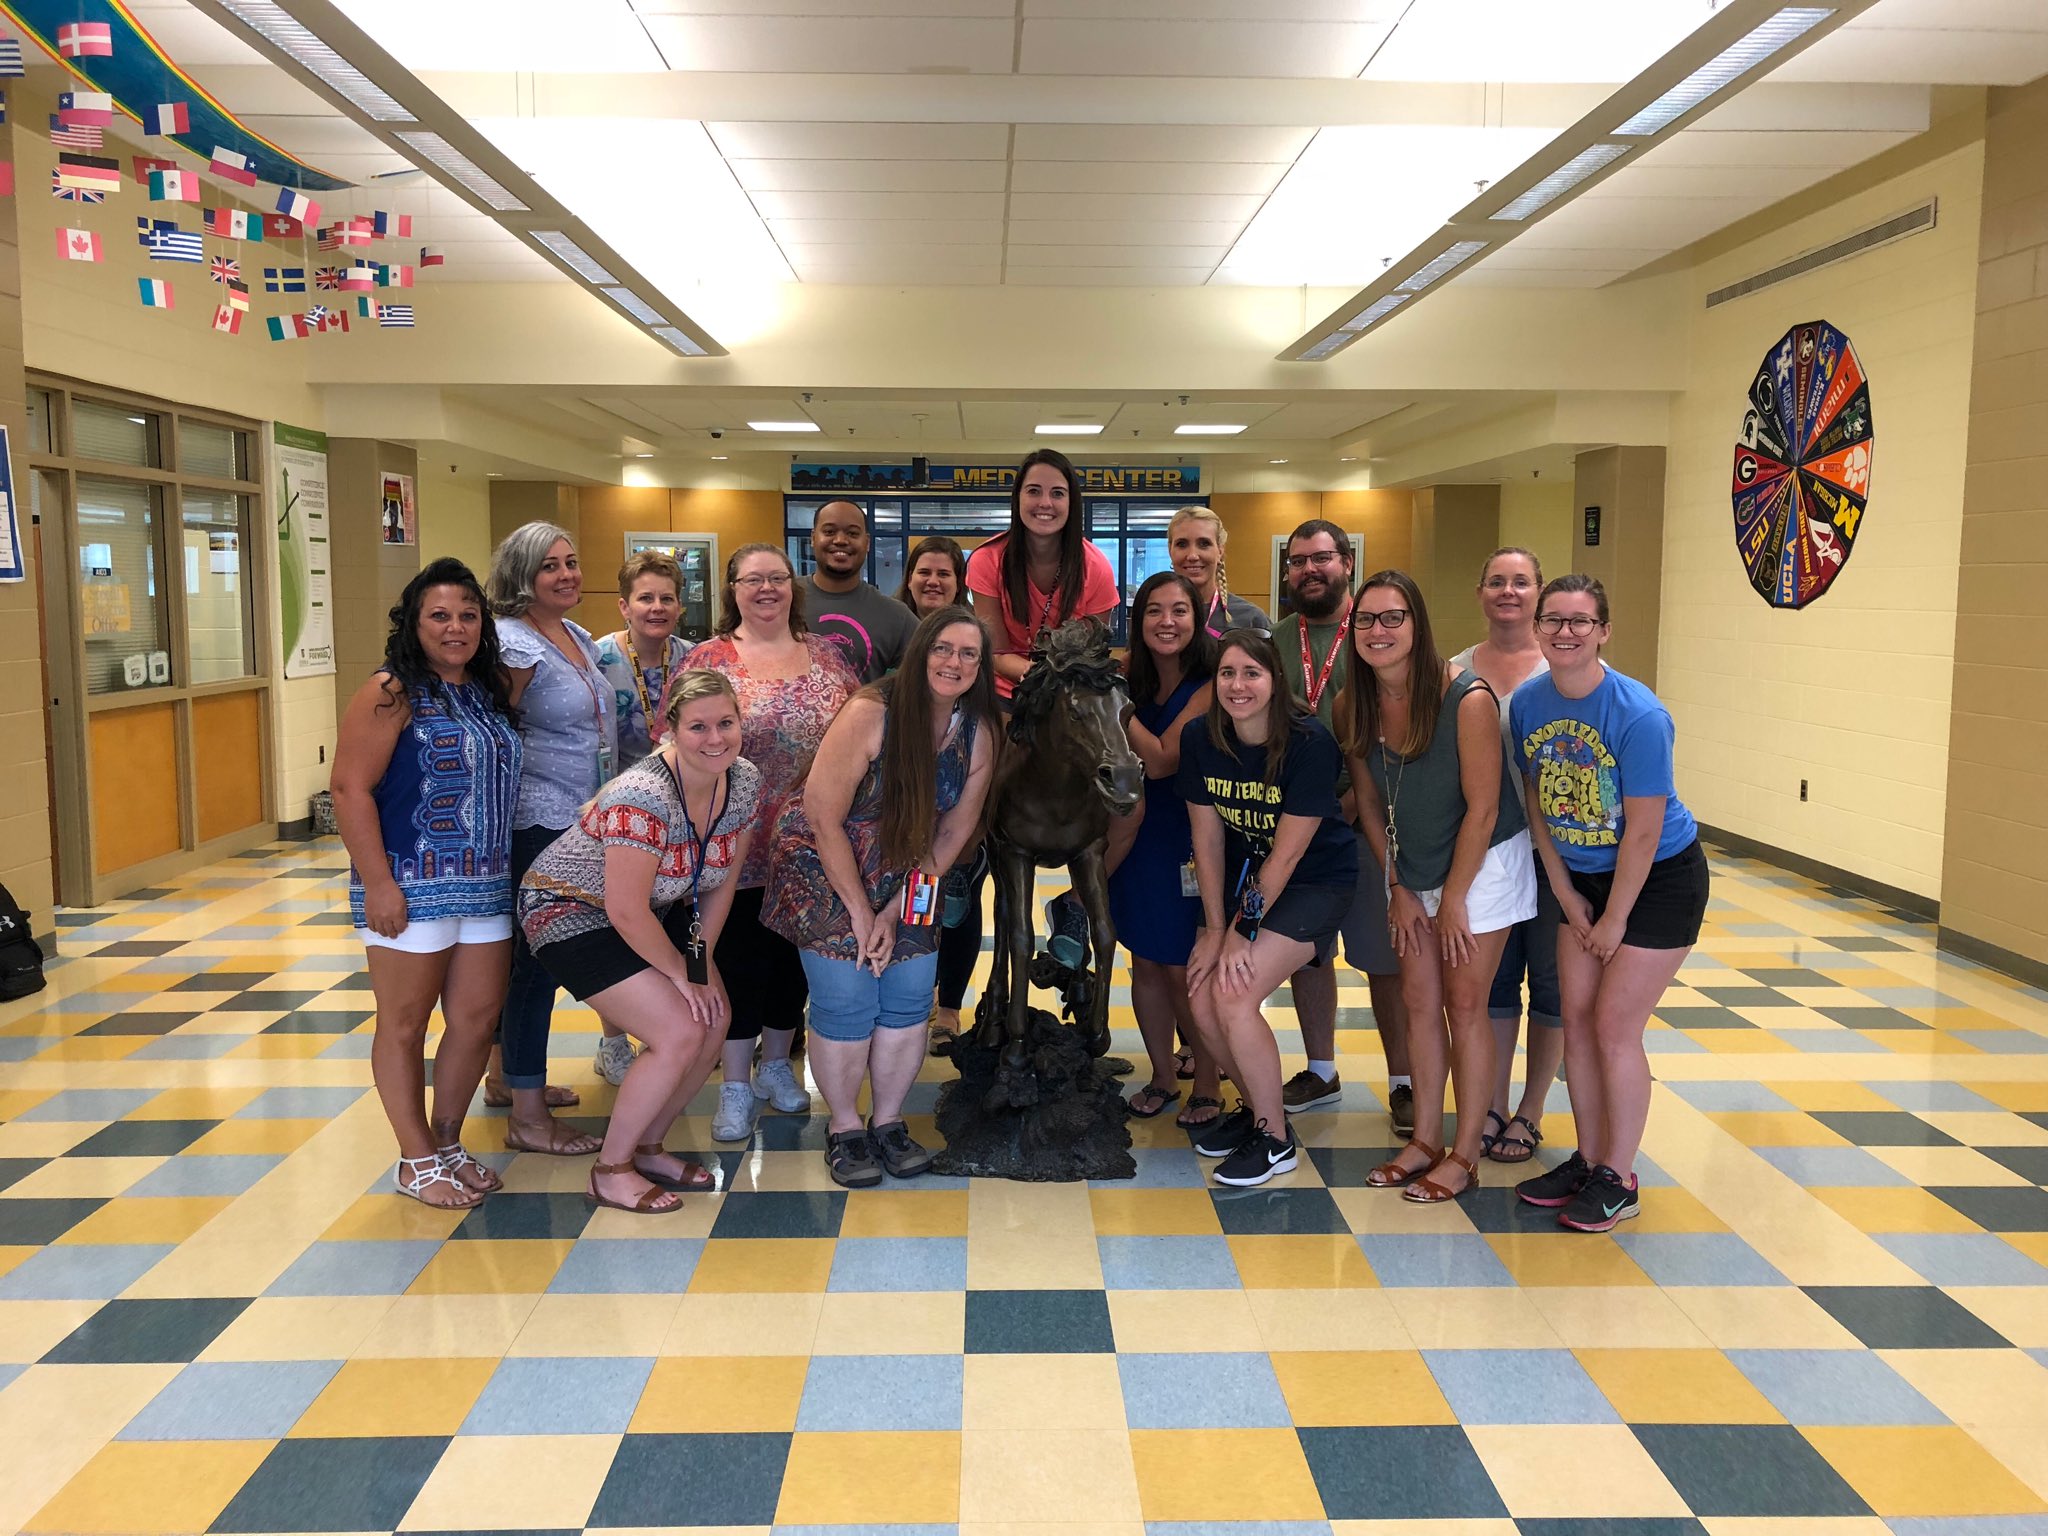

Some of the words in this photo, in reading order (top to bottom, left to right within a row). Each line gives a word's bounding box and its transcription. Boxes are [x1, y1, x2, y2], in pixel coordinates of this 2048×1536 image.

[1797, 366, 1807, 431] SEMINOLES
[1807, 373, 1822, 420] JAYHAWKS
[1812, 382, 1825, 417] KANSAS
[953, 469, 1017, 488] MED
[1744, 517, 1770, 567] LSU
[1798, 511, 1806, 535] STATE
[1783, 538, 1797, 603] UCLA
[1802, 536, 1811, 574] ARIZONA
[1204, 776, 1232, 798] ATH
